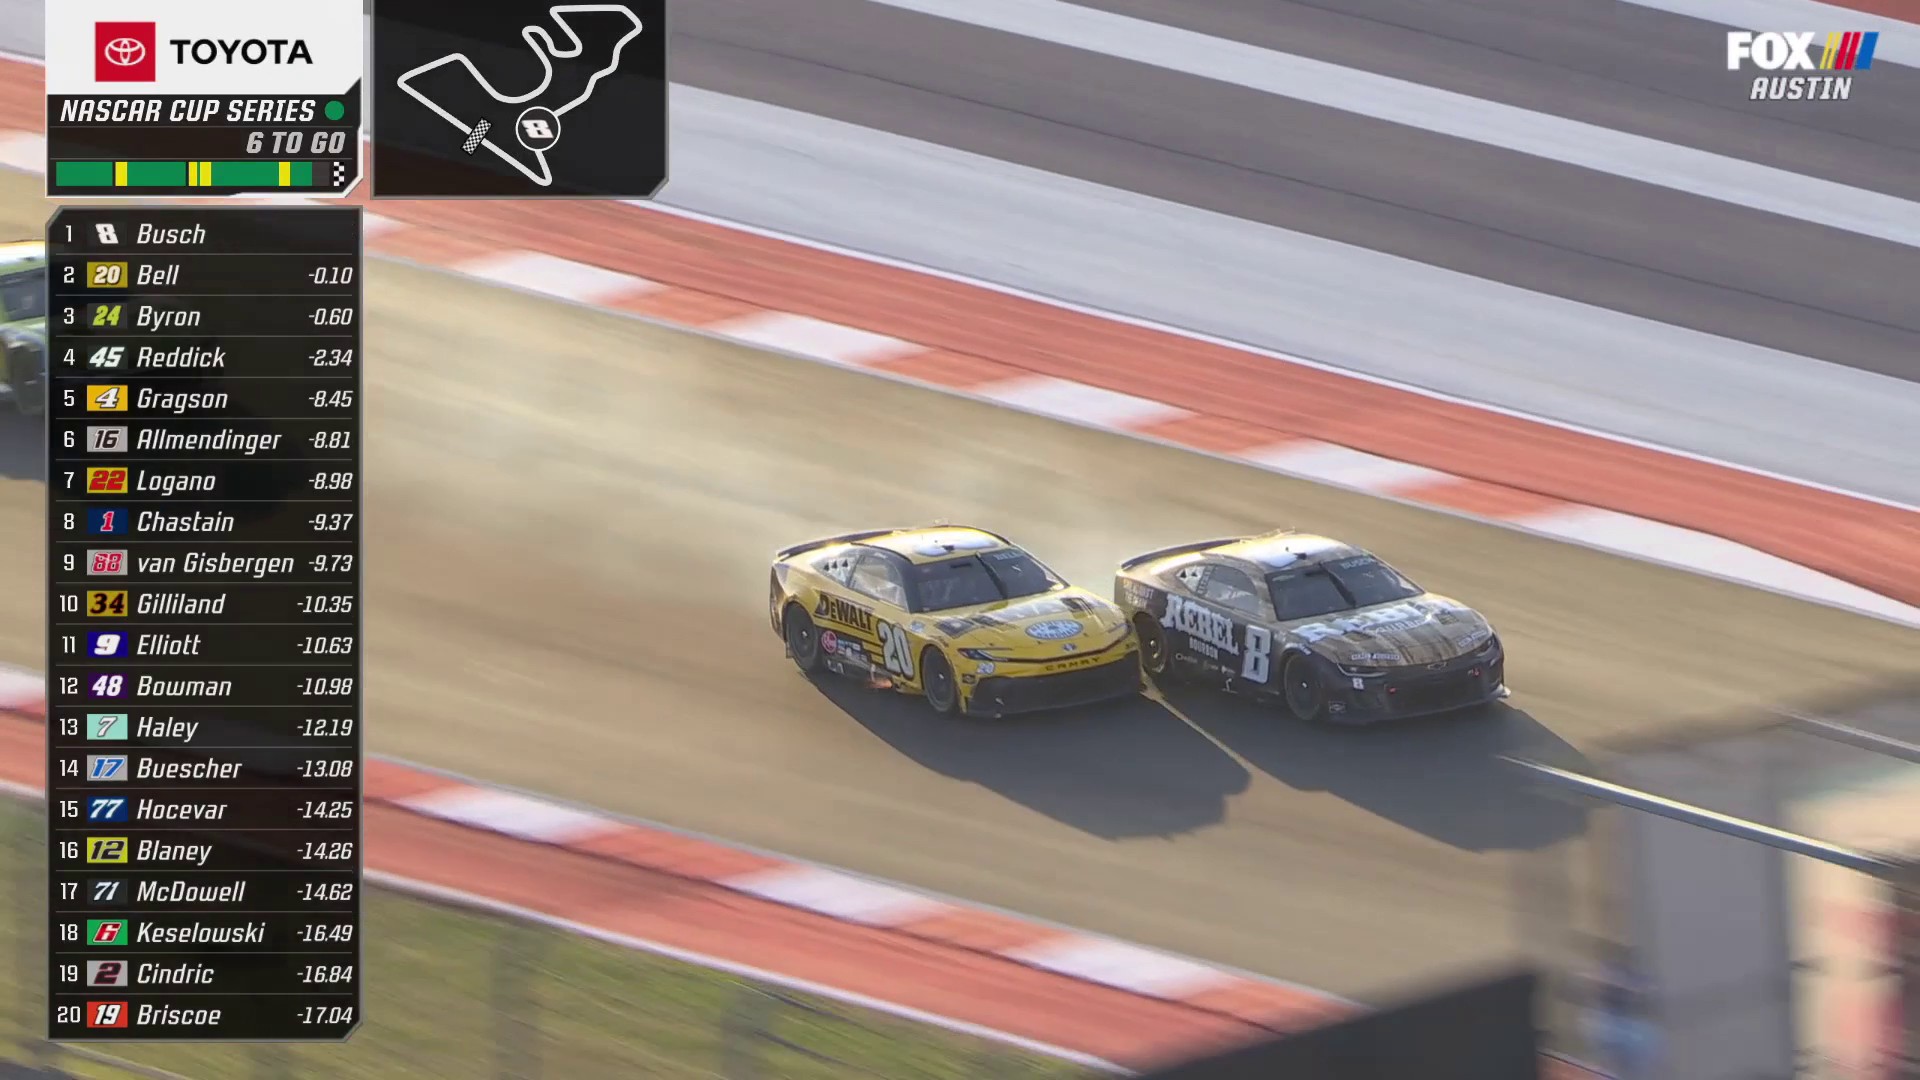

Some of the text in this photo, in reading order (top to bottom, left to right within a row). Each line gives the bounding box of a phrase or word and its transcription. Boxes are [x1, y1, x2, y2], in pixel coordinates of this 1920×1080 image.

[876, 618, 914, 680] 20
[1159, 593, 1239, 656] REBEL
[1241, 624, 1272, 684] 8
[1045, 656, 1101, 671] CAMRY
[1352, 677, 1364, 690] 8
